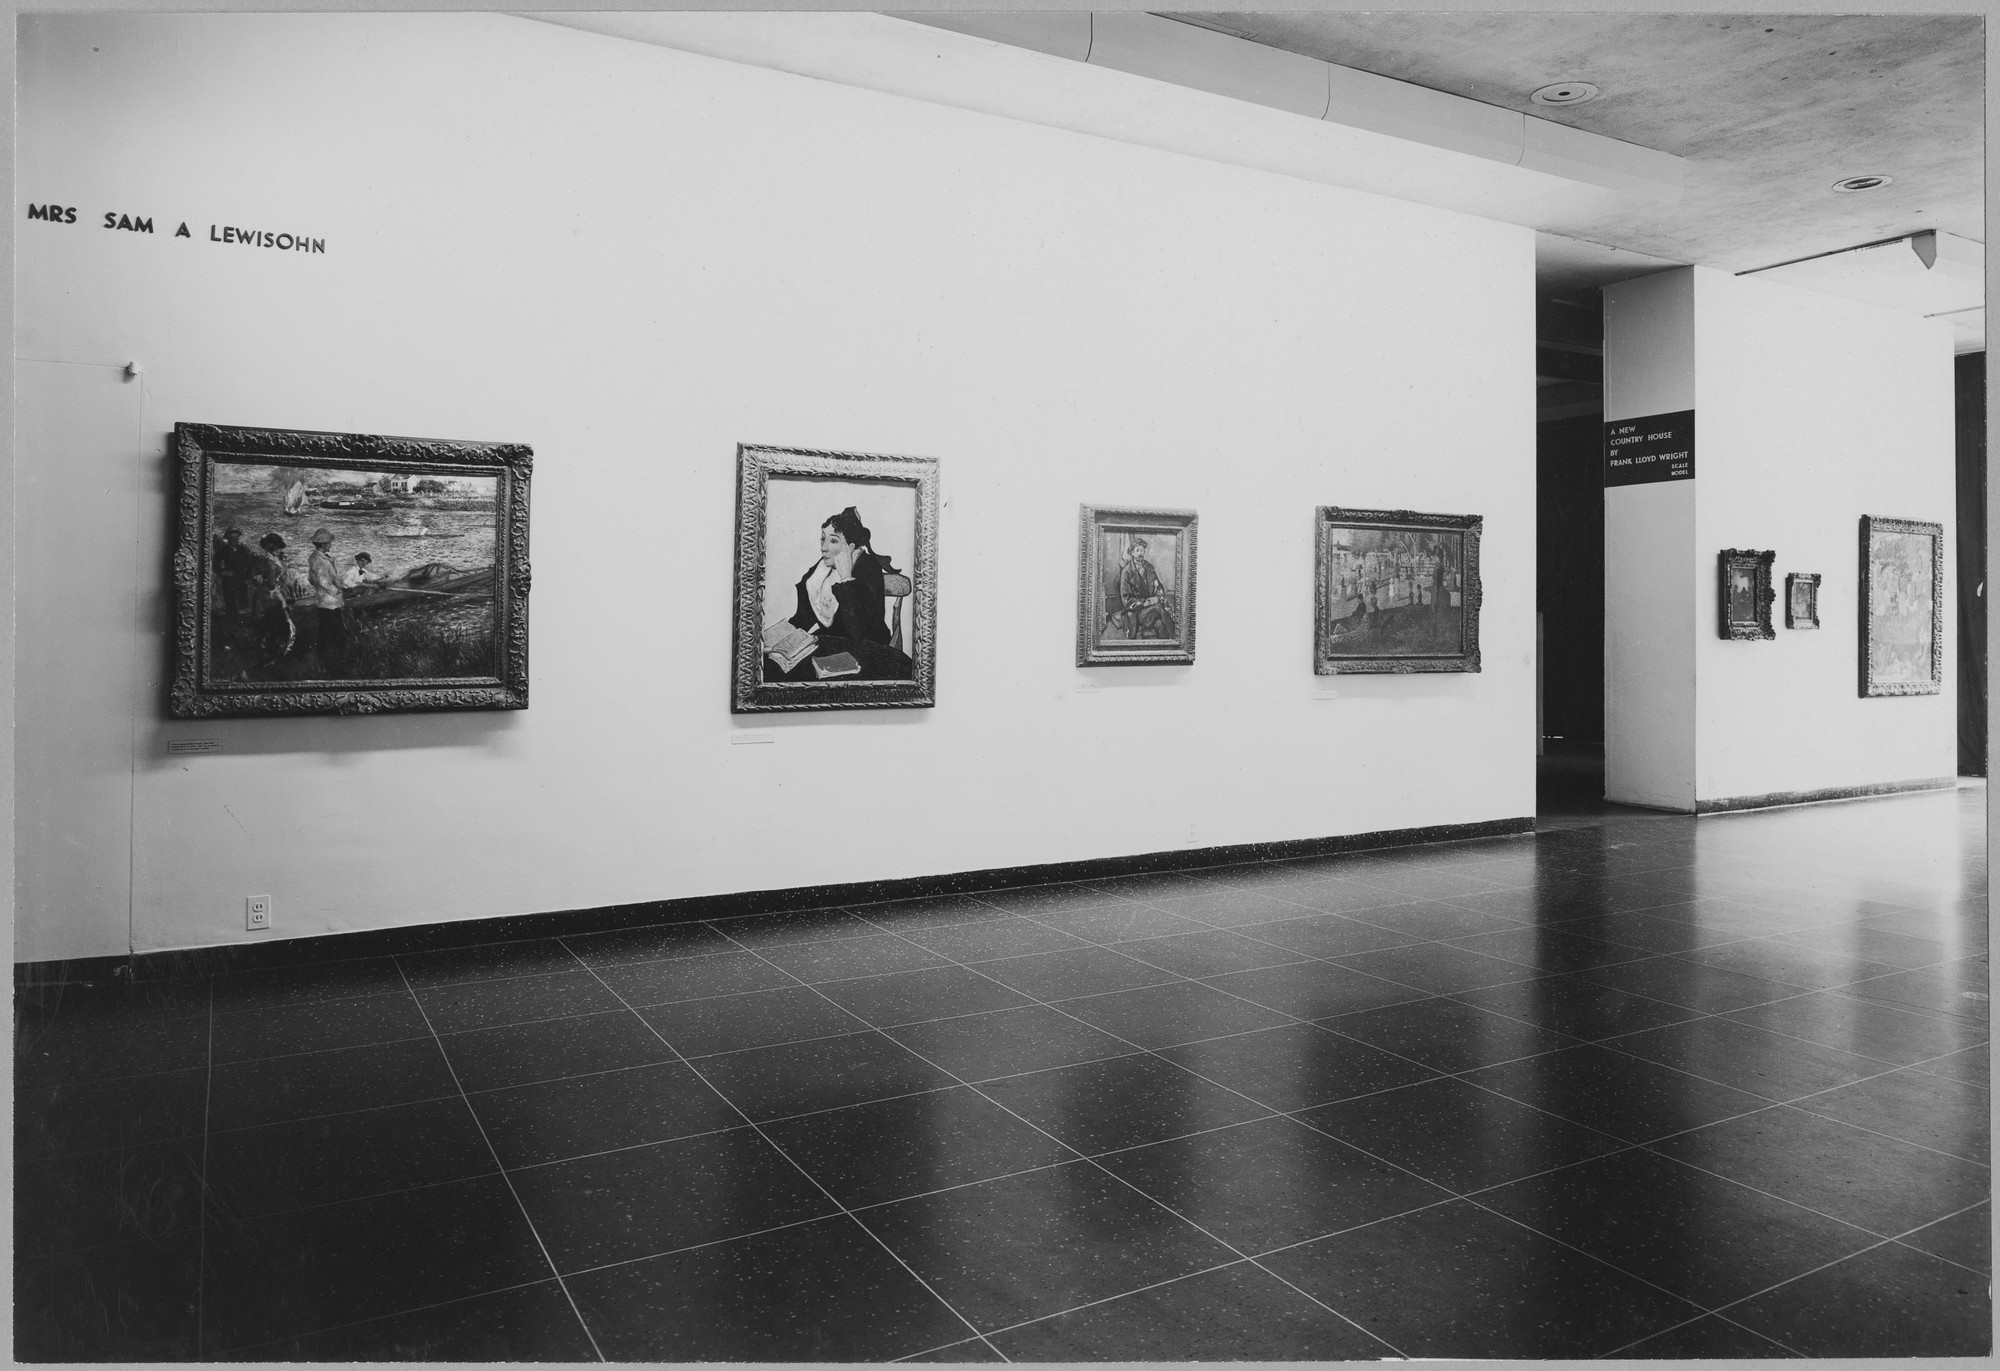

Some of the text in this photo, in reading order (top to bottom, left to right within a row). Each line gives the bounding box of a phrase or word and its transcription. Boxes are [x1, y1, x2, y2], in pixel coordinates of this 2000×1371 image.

[27, 203, 325, 254] MRS SAM A LEWISOHN
[1619, 426, 1636, 435] NEW
[1610, 431, 1672, 446] COUNTRY HOUSE
[1610, 451, 1688, 467] FRANK LLOYD WRIGHT
